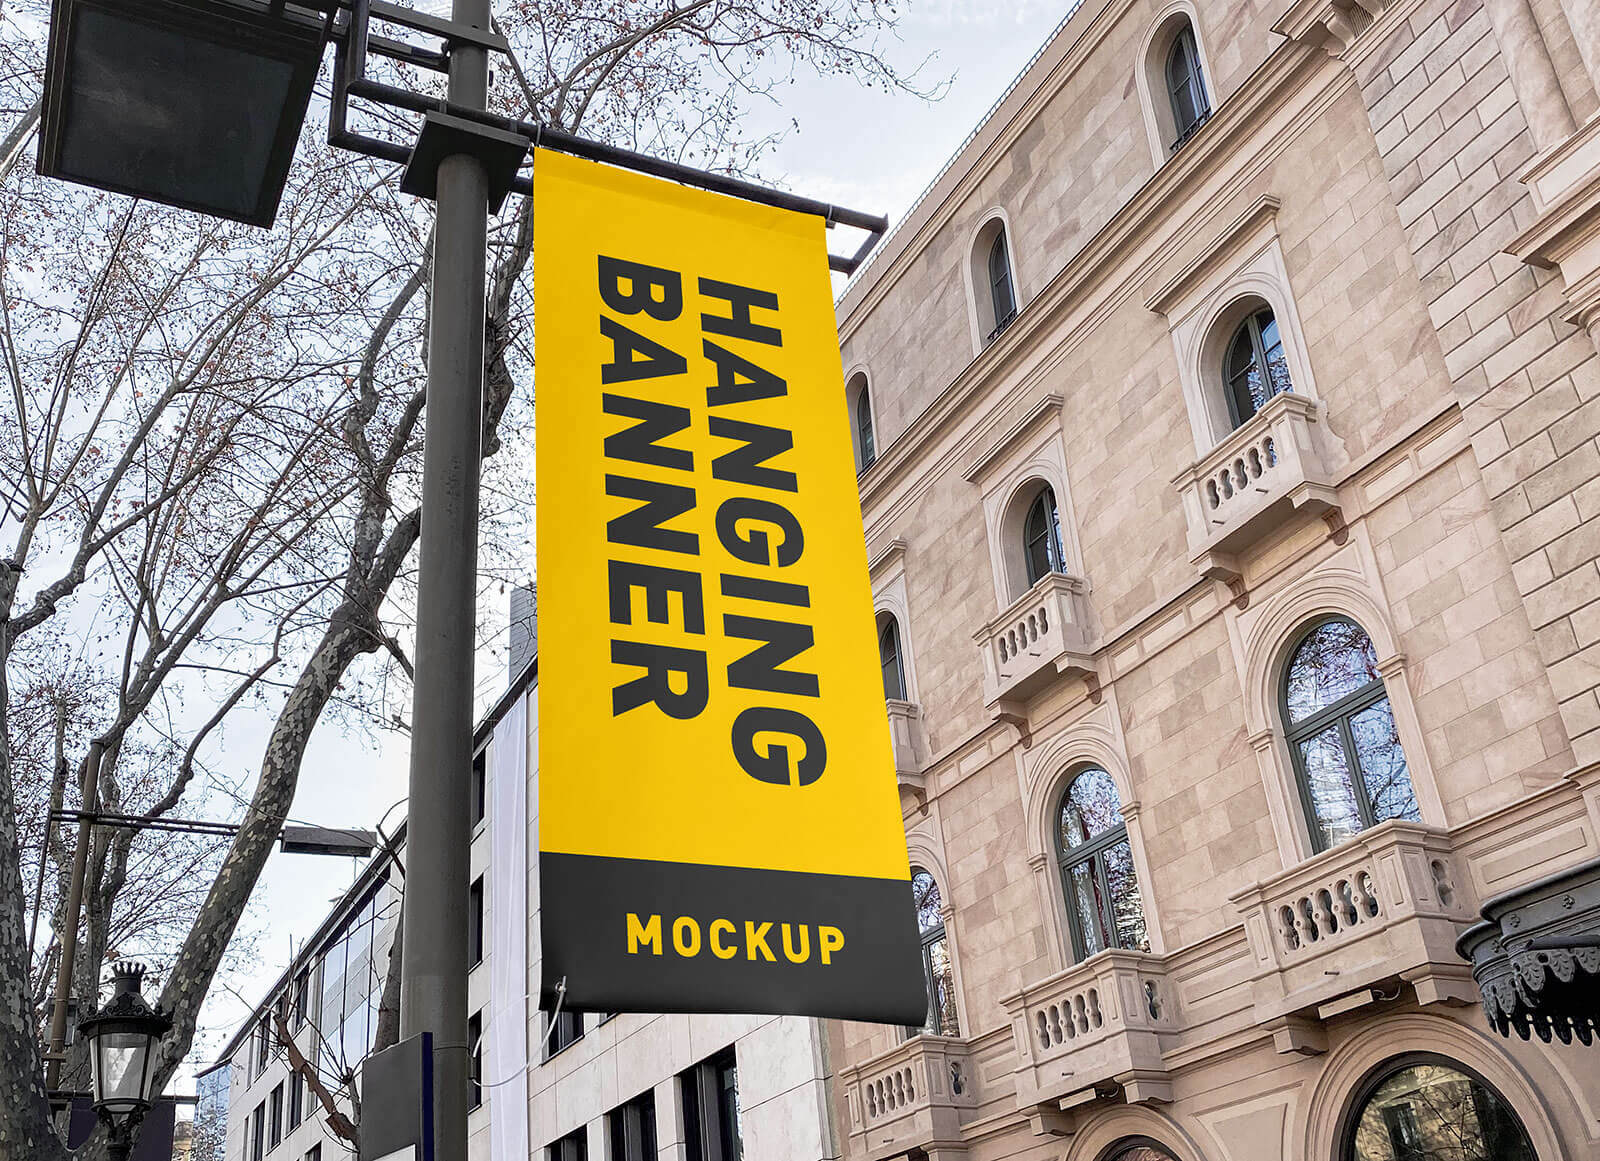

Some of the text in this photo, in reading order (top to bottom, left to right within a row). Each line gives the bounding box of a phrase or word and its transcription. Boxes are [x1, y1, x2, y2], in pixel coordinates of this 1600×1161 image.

[598, 255, 709, 719] BANNER
[698, 277, 827, 786] HANGING
[627, 913, 845, 965] MOCKUP
